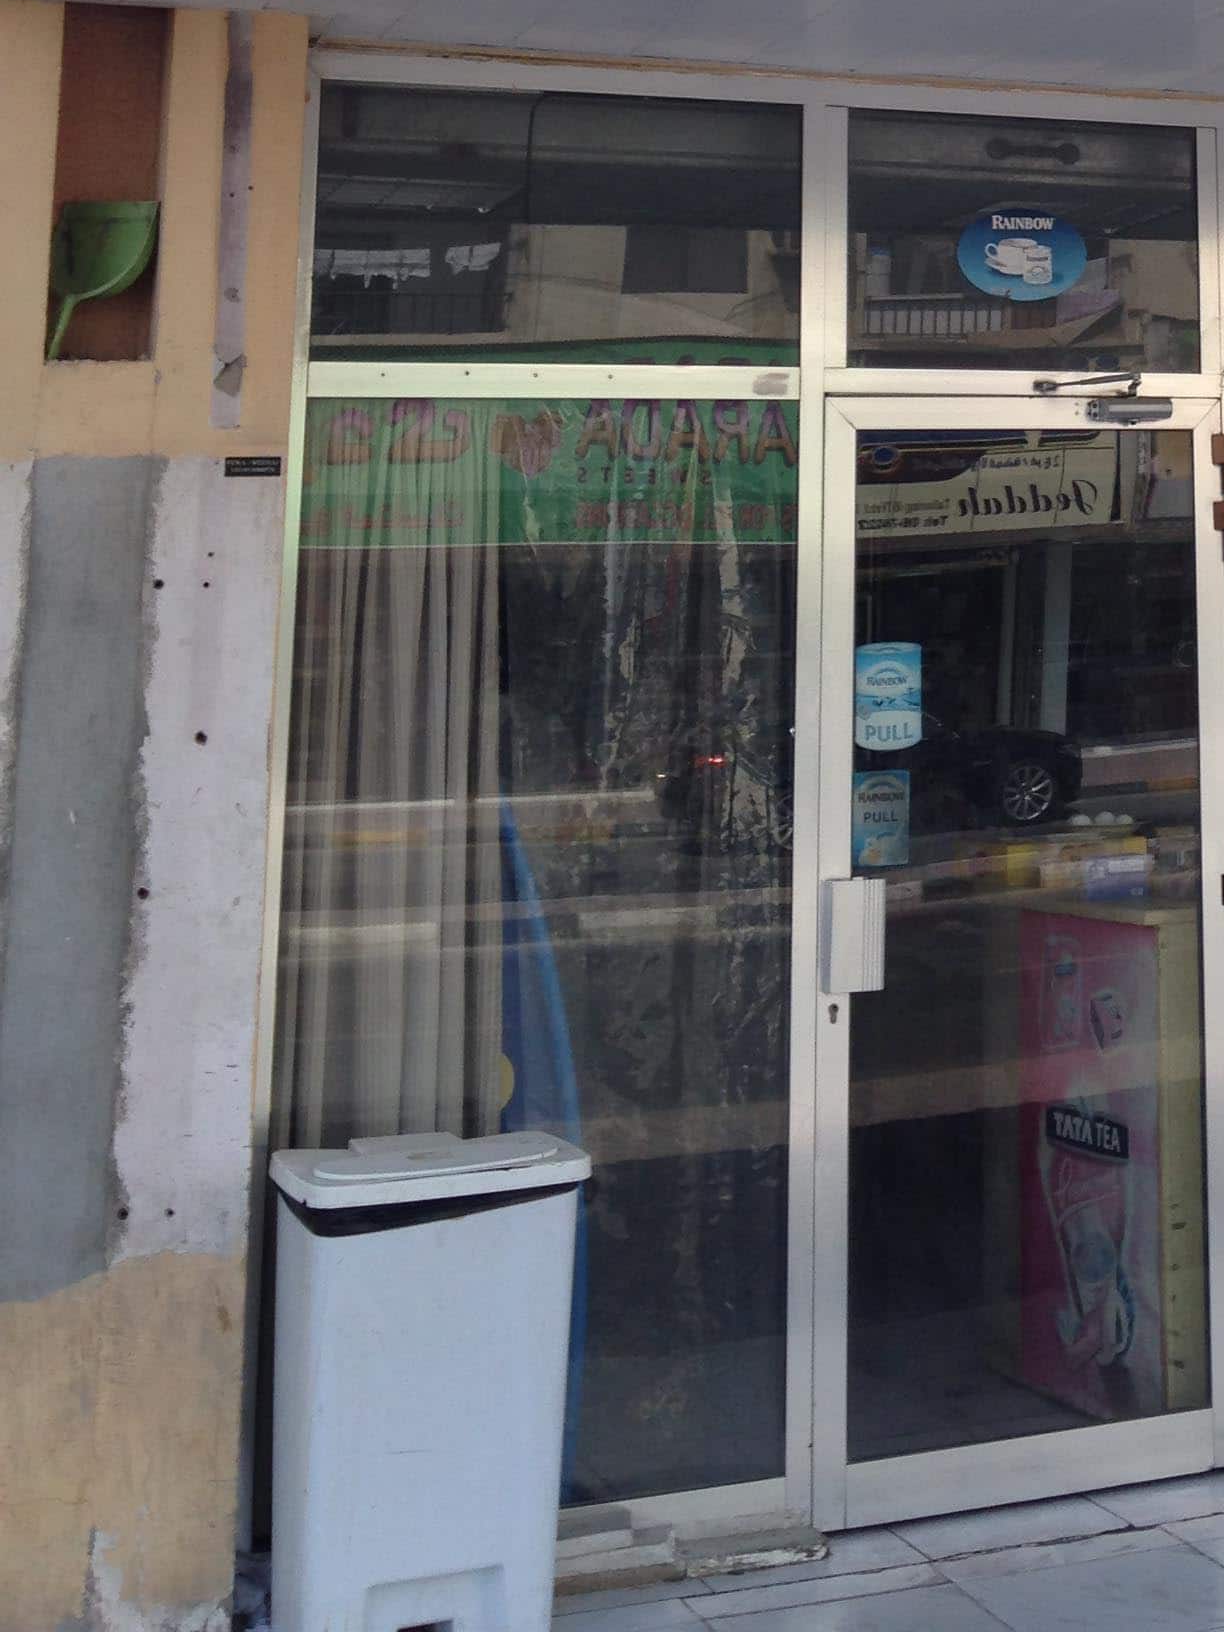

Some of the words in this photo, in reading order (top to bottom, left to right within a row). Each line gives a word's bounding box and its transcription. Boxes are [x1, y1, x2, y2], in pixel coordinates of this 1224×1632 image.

[991, 214, 1055, 230] RAINBOW
[864, 723, 914, 742] PULL
[863, 811, 899, 823] PULL
[1053, 1112, 1093, 1145] TATA
[1096, 1122, 1121, 1153] TEA
